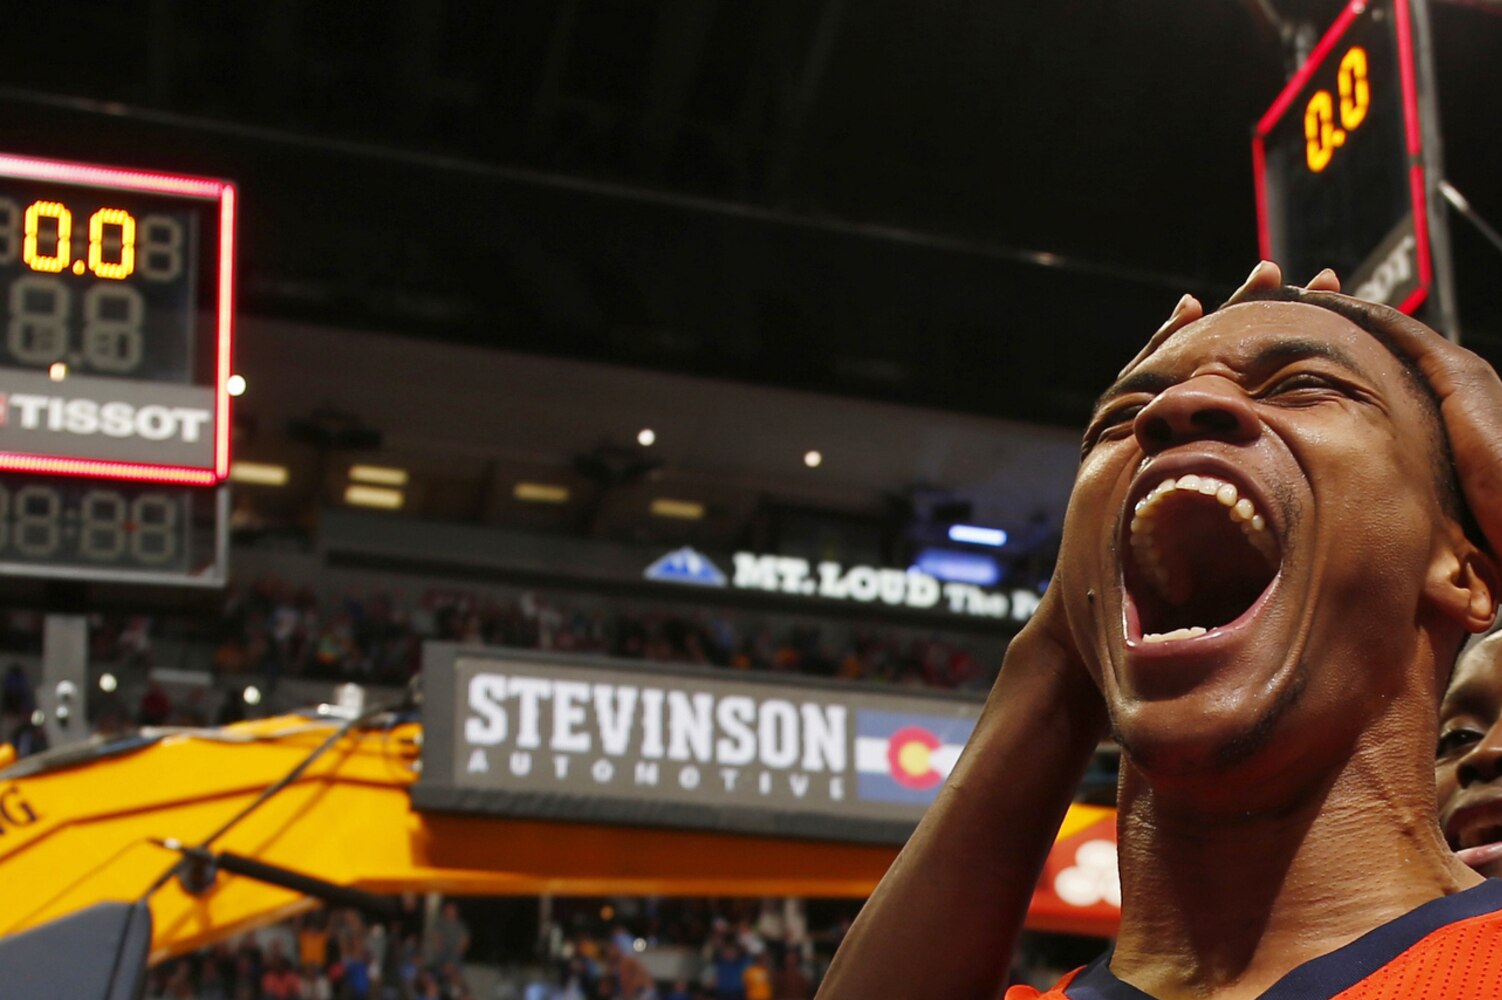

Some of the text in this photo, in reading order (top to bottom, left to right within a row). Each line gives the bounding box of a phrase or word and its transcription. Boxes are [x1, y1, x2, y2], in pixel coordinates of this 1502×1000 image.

[1304, 46, 1370, 172] 0.0
[22, 199, 136, 280] 0.0
[11, 393, 212, 442] TISSOT
[818, 561, 940, 608] LOUD
[465, 672, 848, 774] STEVINSON
[467, 748, 846, 800] AUTOMOTIVE
